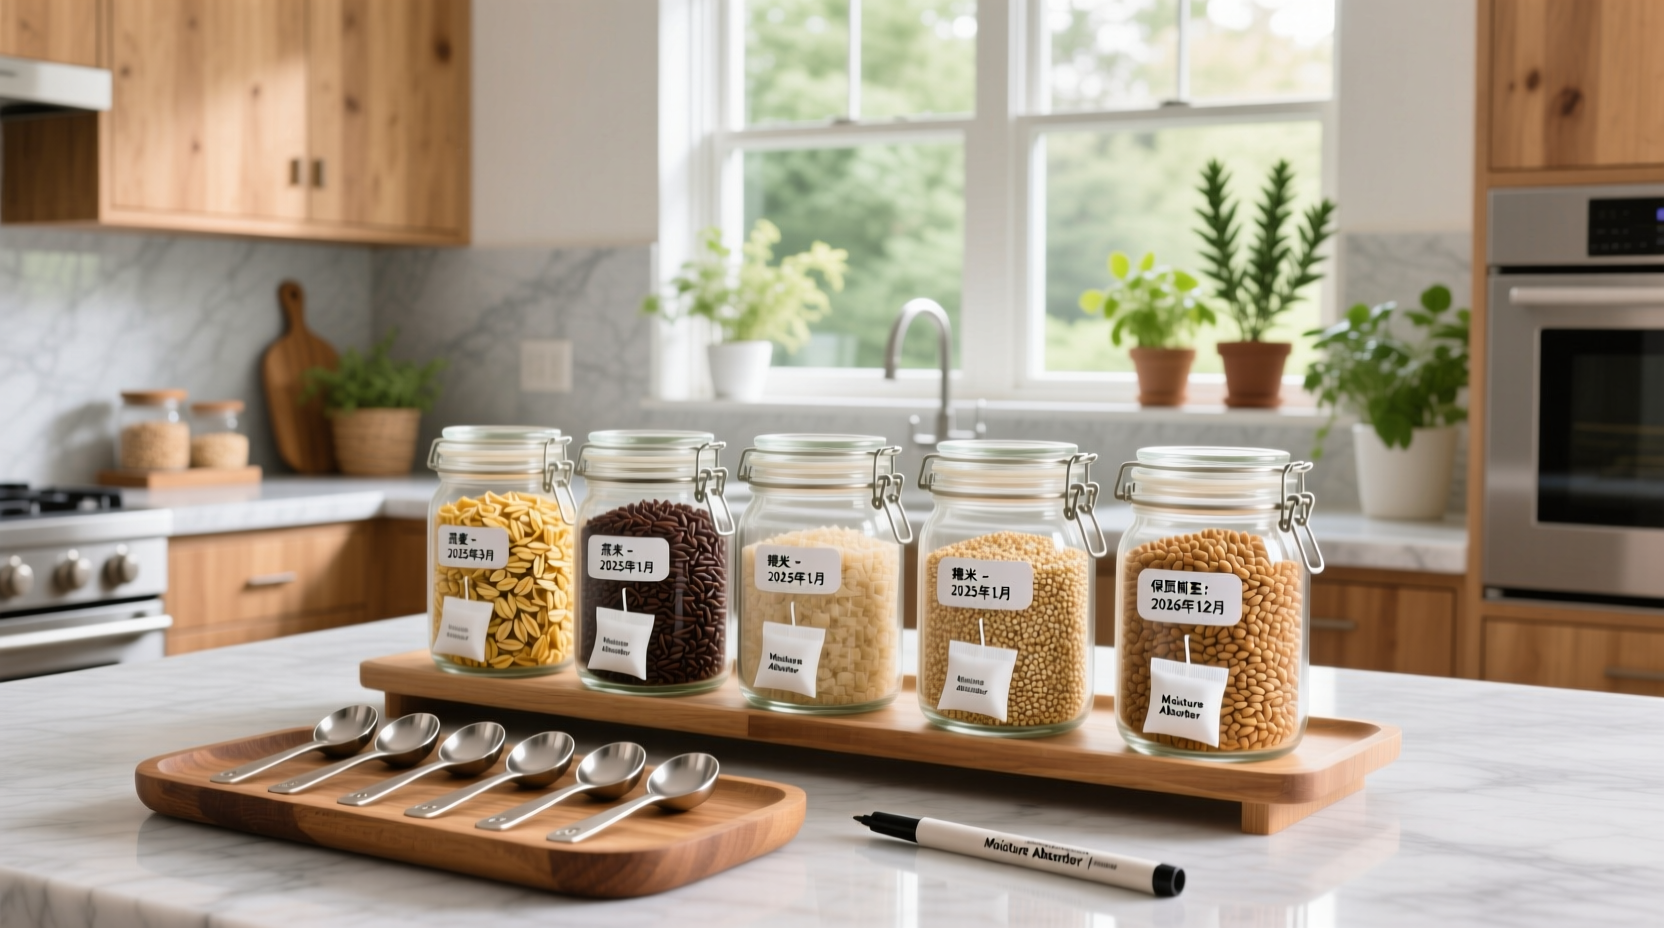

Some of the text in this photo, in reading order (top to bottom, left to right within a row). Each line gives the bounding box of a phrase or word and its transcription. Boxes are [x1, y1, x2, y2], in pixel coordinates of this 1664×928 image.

[600, 560, 654, 574] 2025年1月
[768, 571, 825, 586] 2025年1月
[951, 584, 1010, 601] 2025年1月
[1151, 598, 1224, 615] 2026年12月
